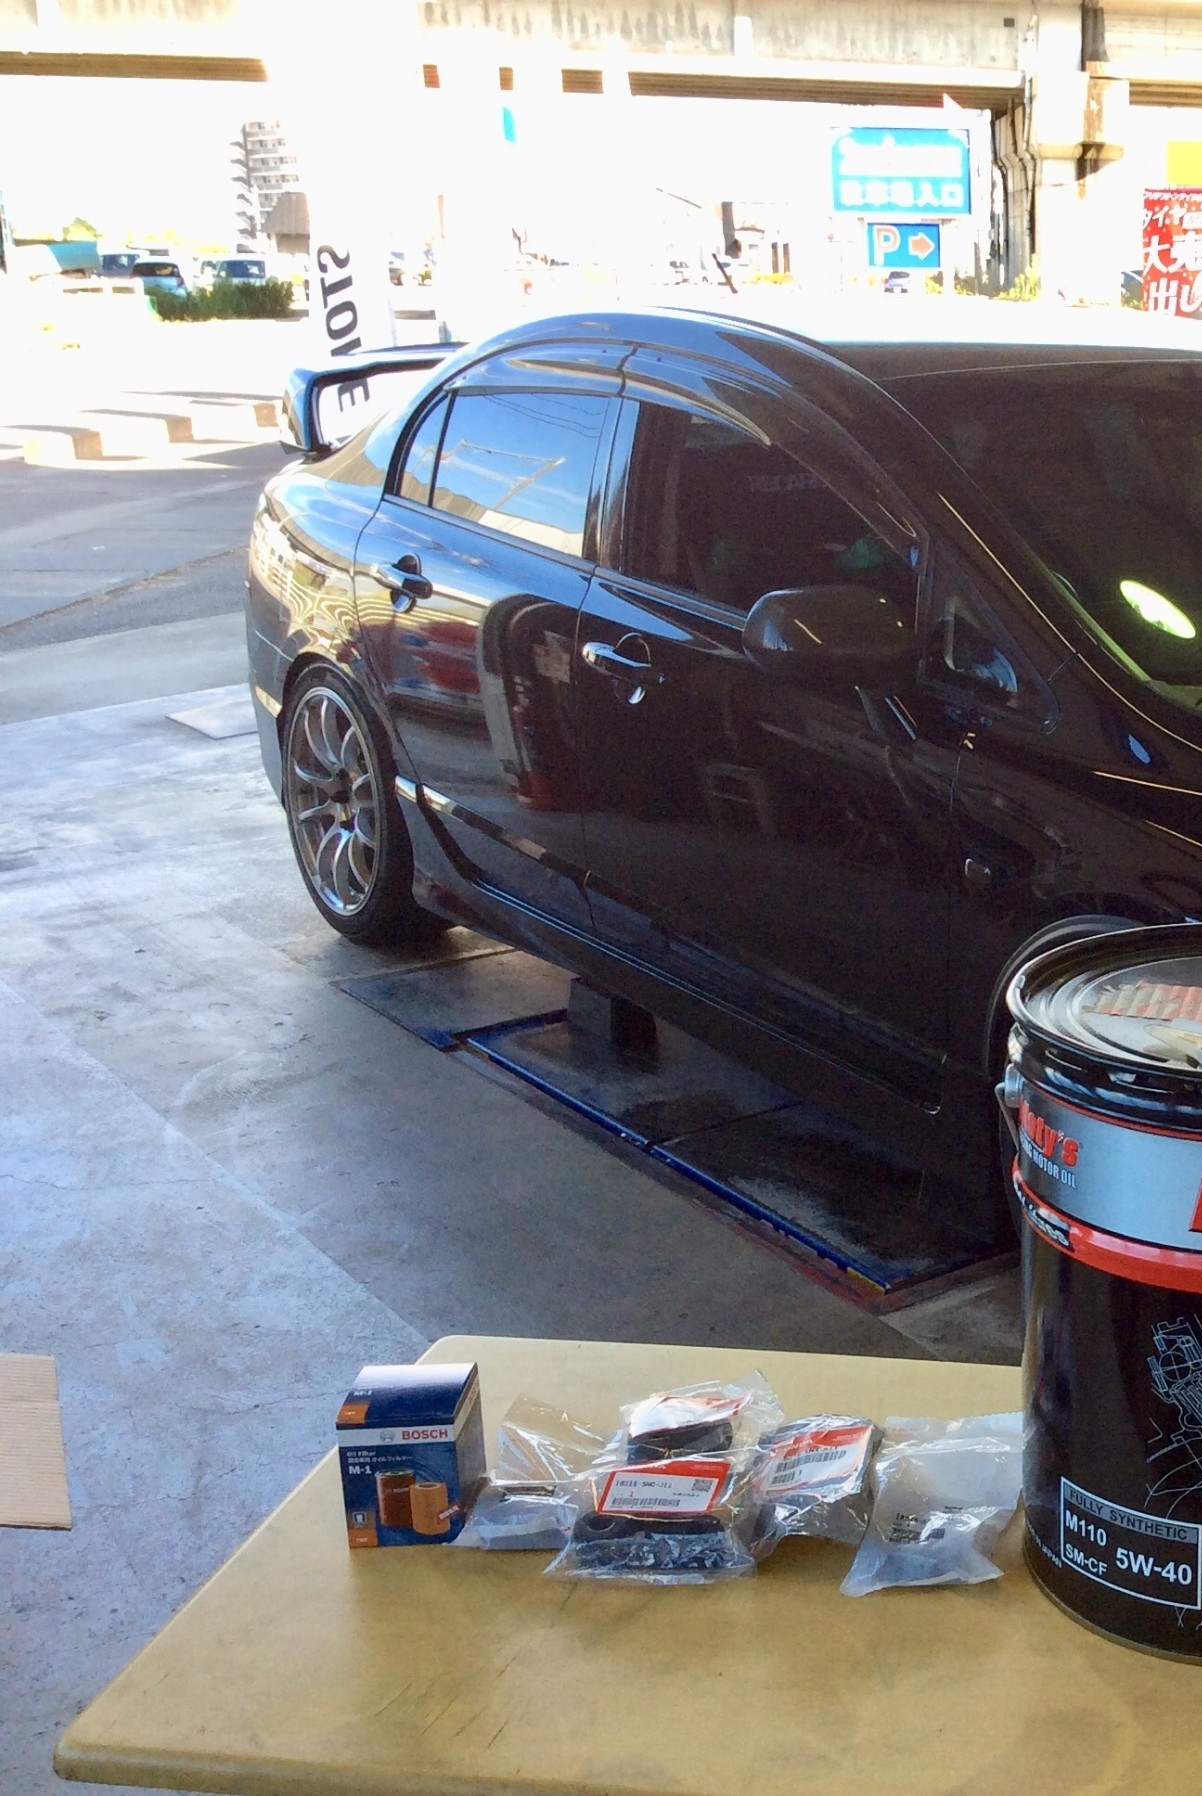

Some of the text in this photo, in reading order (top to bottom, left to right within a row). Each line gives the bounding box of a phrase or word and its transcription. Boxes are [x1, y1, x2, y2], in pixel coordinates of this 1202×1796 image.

[873, 224, 901, 267] P
[1060, 1168, 1077, 1189] OIL
[401, 1428, 448, 1440] BOSCH
[348, 1465, 373, 1475] M-1
[1065, 1509, 1108, 1547] M110
[1070, 1490, 1188, 1541] FULLY SYNTHETIC
[1065, 1543, 1193, 1586] SM-CF 5W-40
